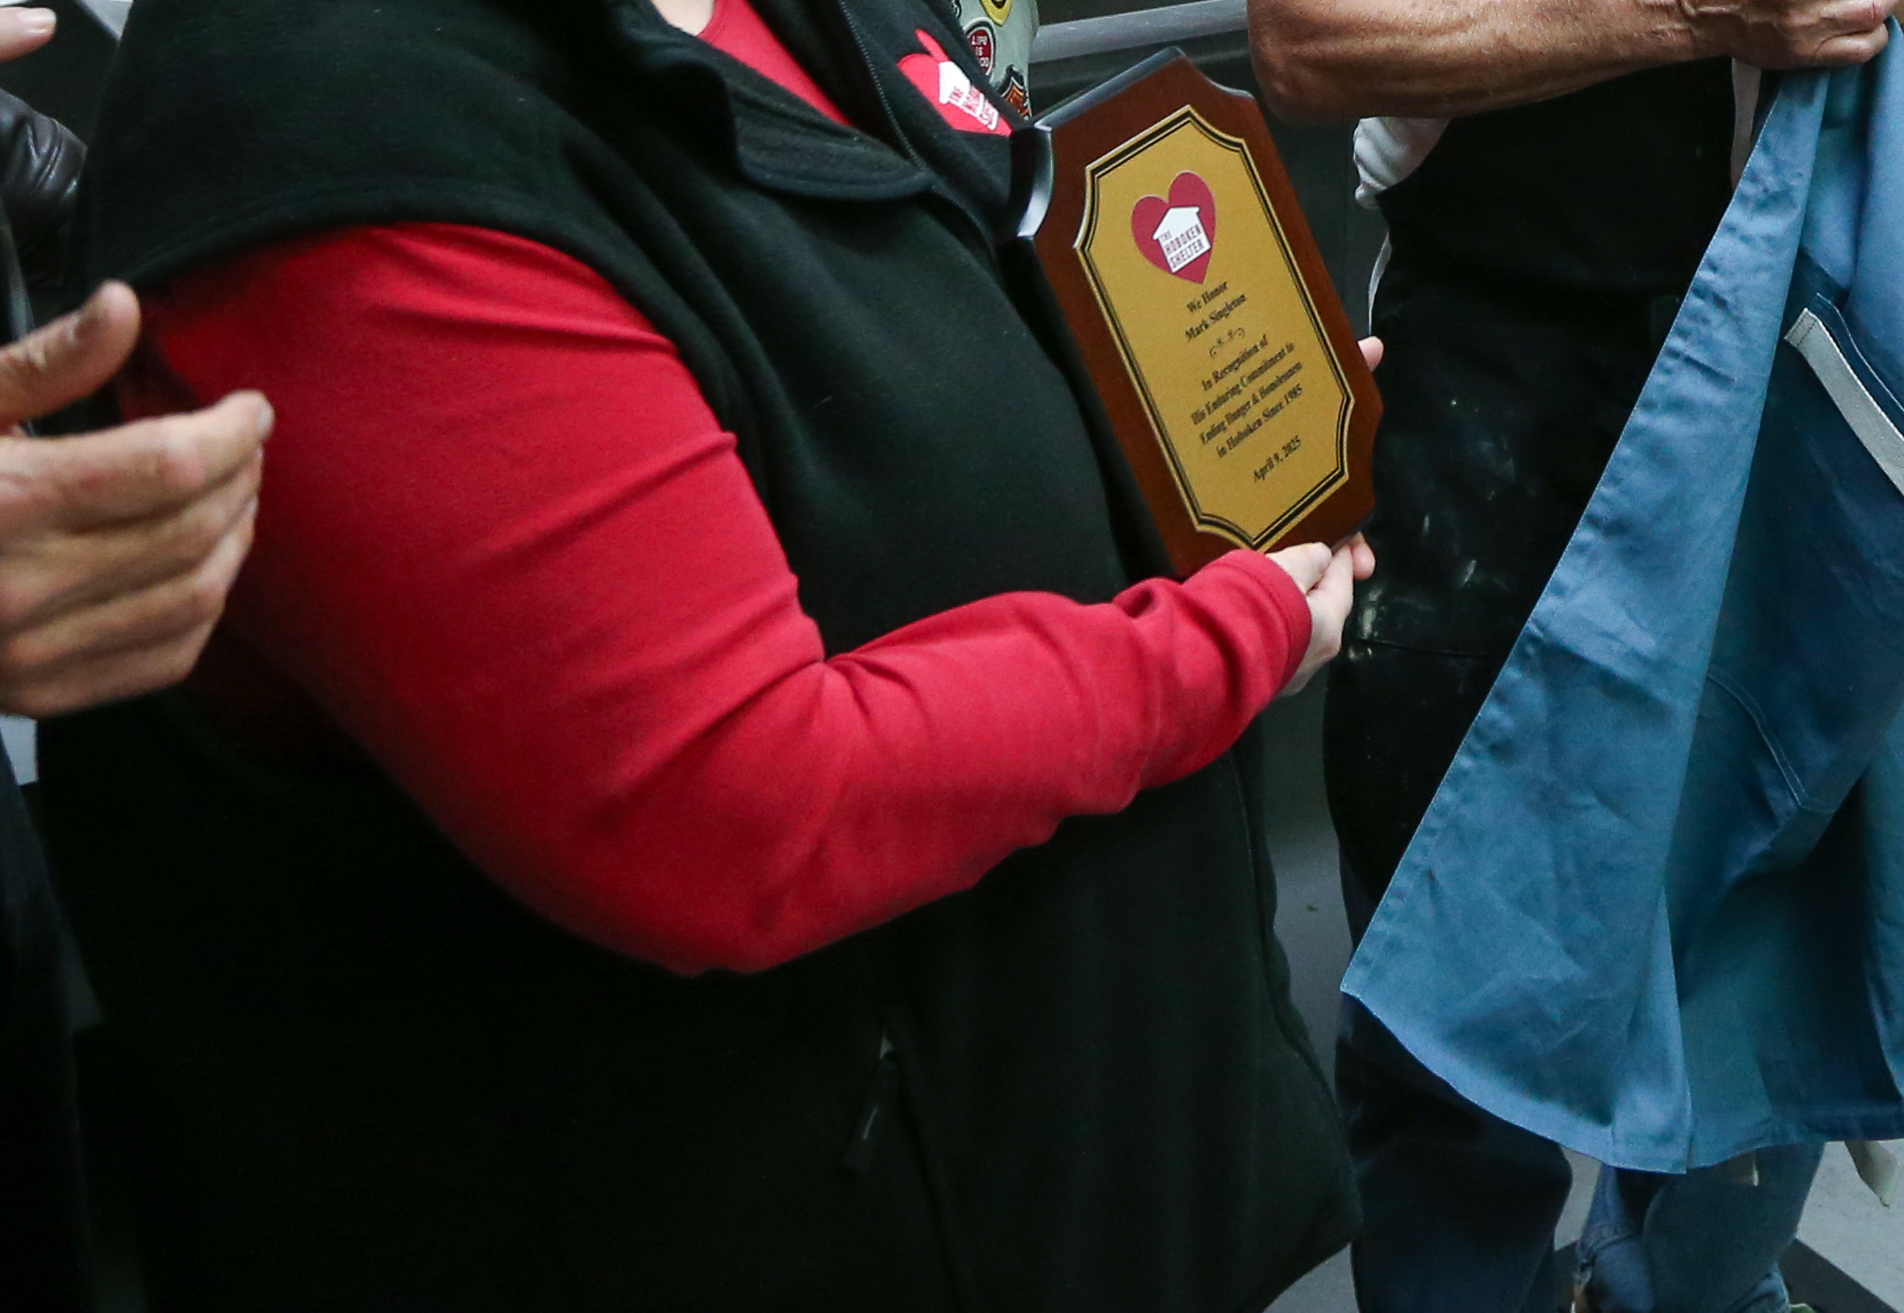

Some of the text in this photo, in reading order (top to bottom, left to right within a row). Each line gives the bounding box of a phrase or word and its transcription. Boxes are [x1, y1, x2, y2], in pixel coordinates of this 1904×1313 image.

[1164, 223, 1203, 256] HOBOKEN
[1168, 238, 1205, 269] SHELTER
[1184, 293, 1247, 342] Mark Singleton
[1186, 280, 1228, 313] We Honor
[1205, 383, 1242, 415] Enduring
[1240, 347, 1286, 387] Commitment
[1284, 342, 1295, 354] to
[1212, 344, 1260, 384] Recognition
[1259, 333, 1269, 348] of
[1199, 361, 1303, 445] Ending Hunger & Homelessness
[1226, 417, 1263, 451] Hoboken
[1261, 401, 1285, 422] Since
[1283, 383, 1303, 406] 1985
[1253, 456, 1275, 484] April
[1282, 434, 1302, 458] 2025
